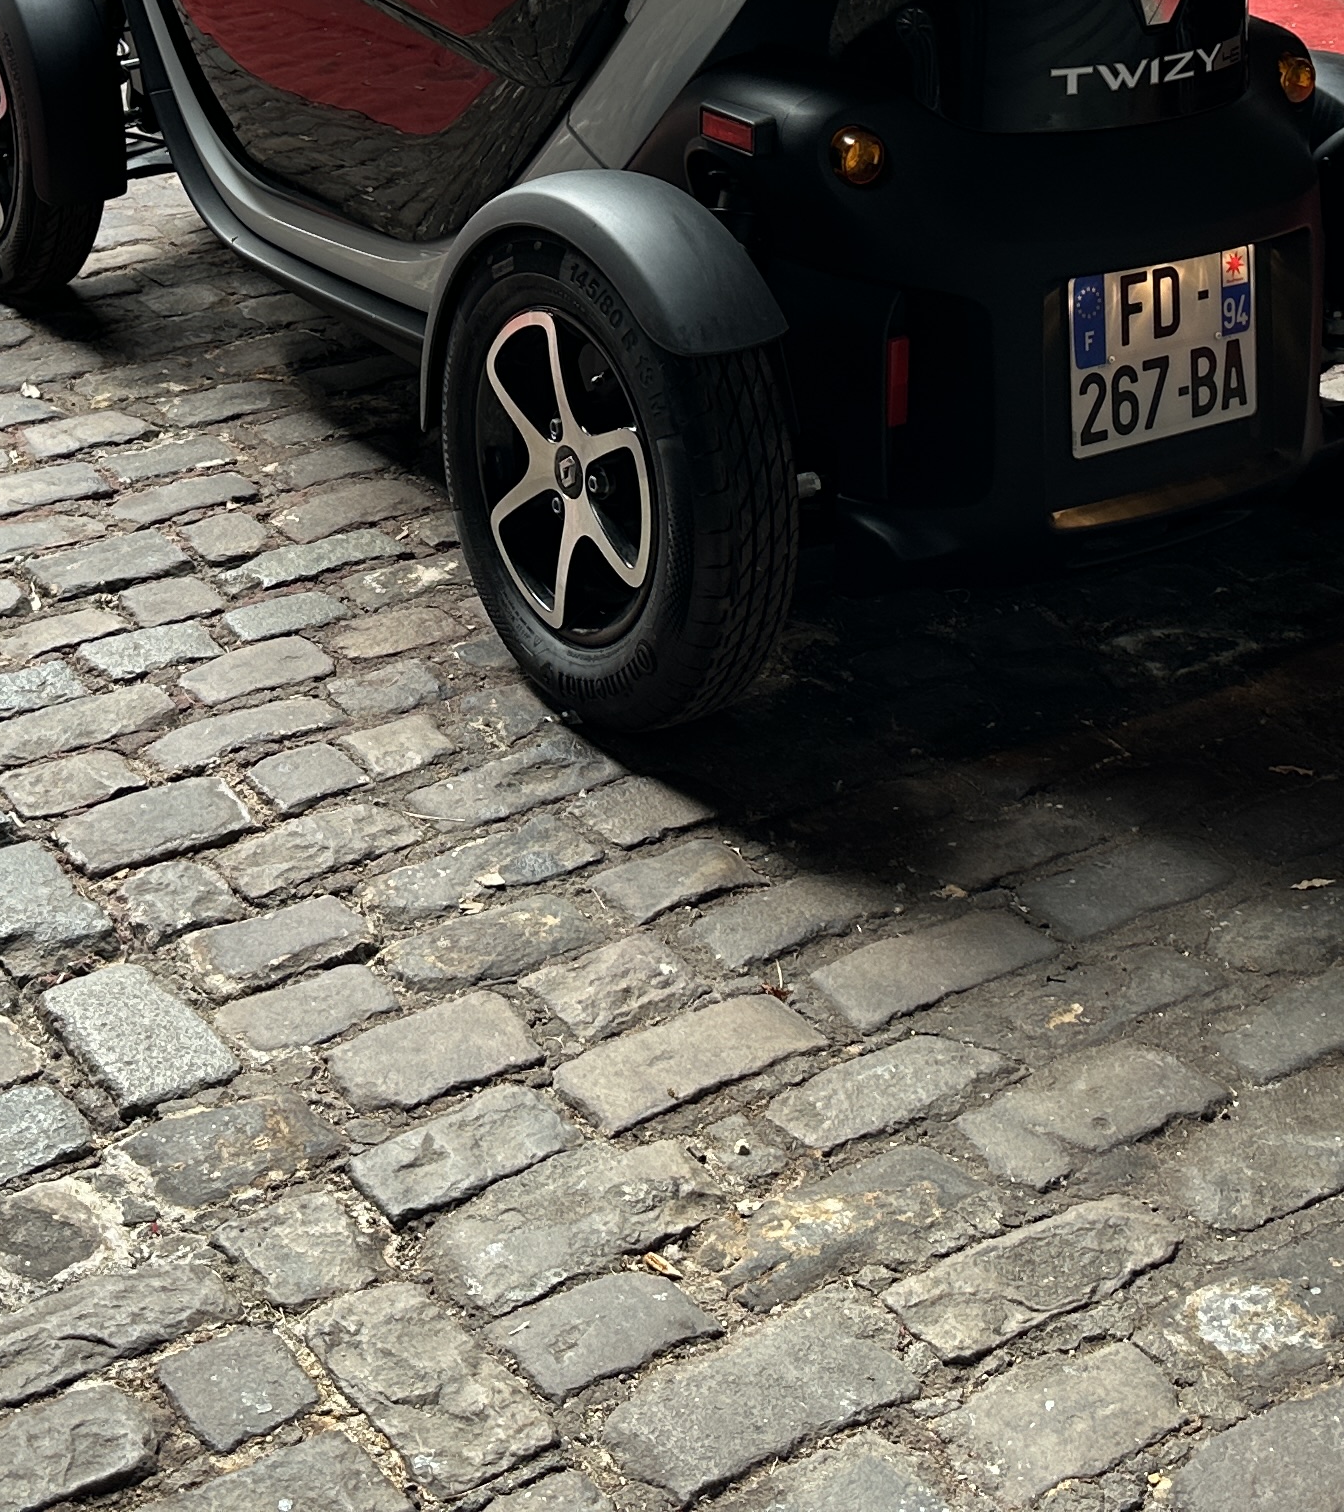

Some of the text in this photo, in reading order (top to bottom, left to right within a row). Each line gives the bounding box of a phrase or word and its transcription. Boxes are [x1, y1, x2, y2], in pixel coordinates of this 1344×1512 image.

[1050, 43, 1222, 95] TWIZY
[569, 263, 623, 329] 145/80
[1223, 294, 1248, 330] 94
[1084, 331, 1095, 351] F
[1079, 338, 1247, 446] 267-BA
